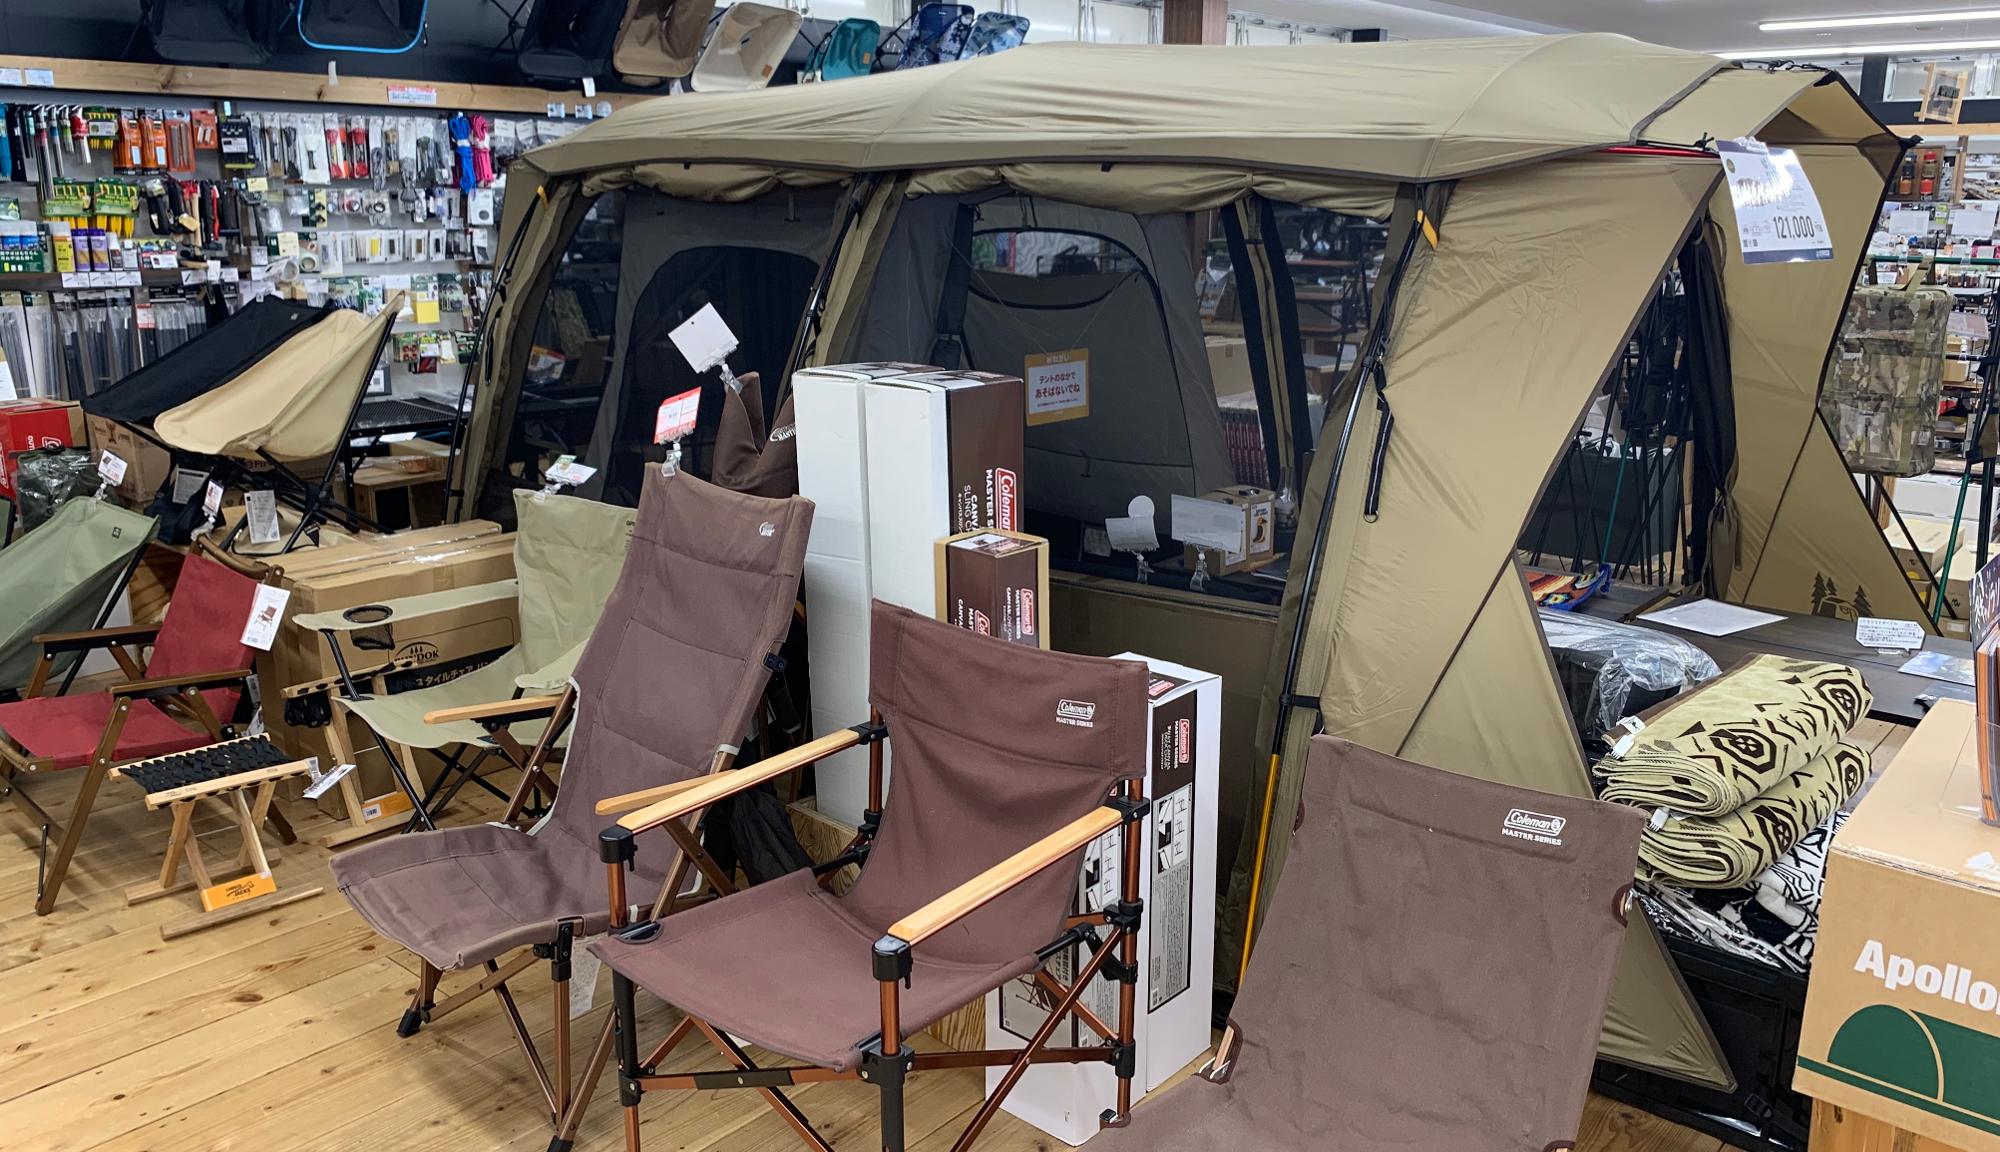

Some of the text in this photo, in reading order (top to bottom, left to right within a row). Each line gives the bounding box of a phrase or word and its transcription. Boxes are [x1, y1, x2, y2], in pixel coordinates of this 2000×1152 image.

[1772, 215, 1815, 240] 121,000
[1035, 384, 1080, 399] あそばないでね
[985, 469, 993, 517] MASTER
[1061, 701, 1087, 714] Coleman
[1056, 716, 1076, 726] MASTER
[1180, 721, 1188, 753] Coleman
[1510, 812, 1551, 829] Coleman
[1501, 828, 1562, 846] MASTER SERIES
[1853, 939, 2000, 1016] Apollo
